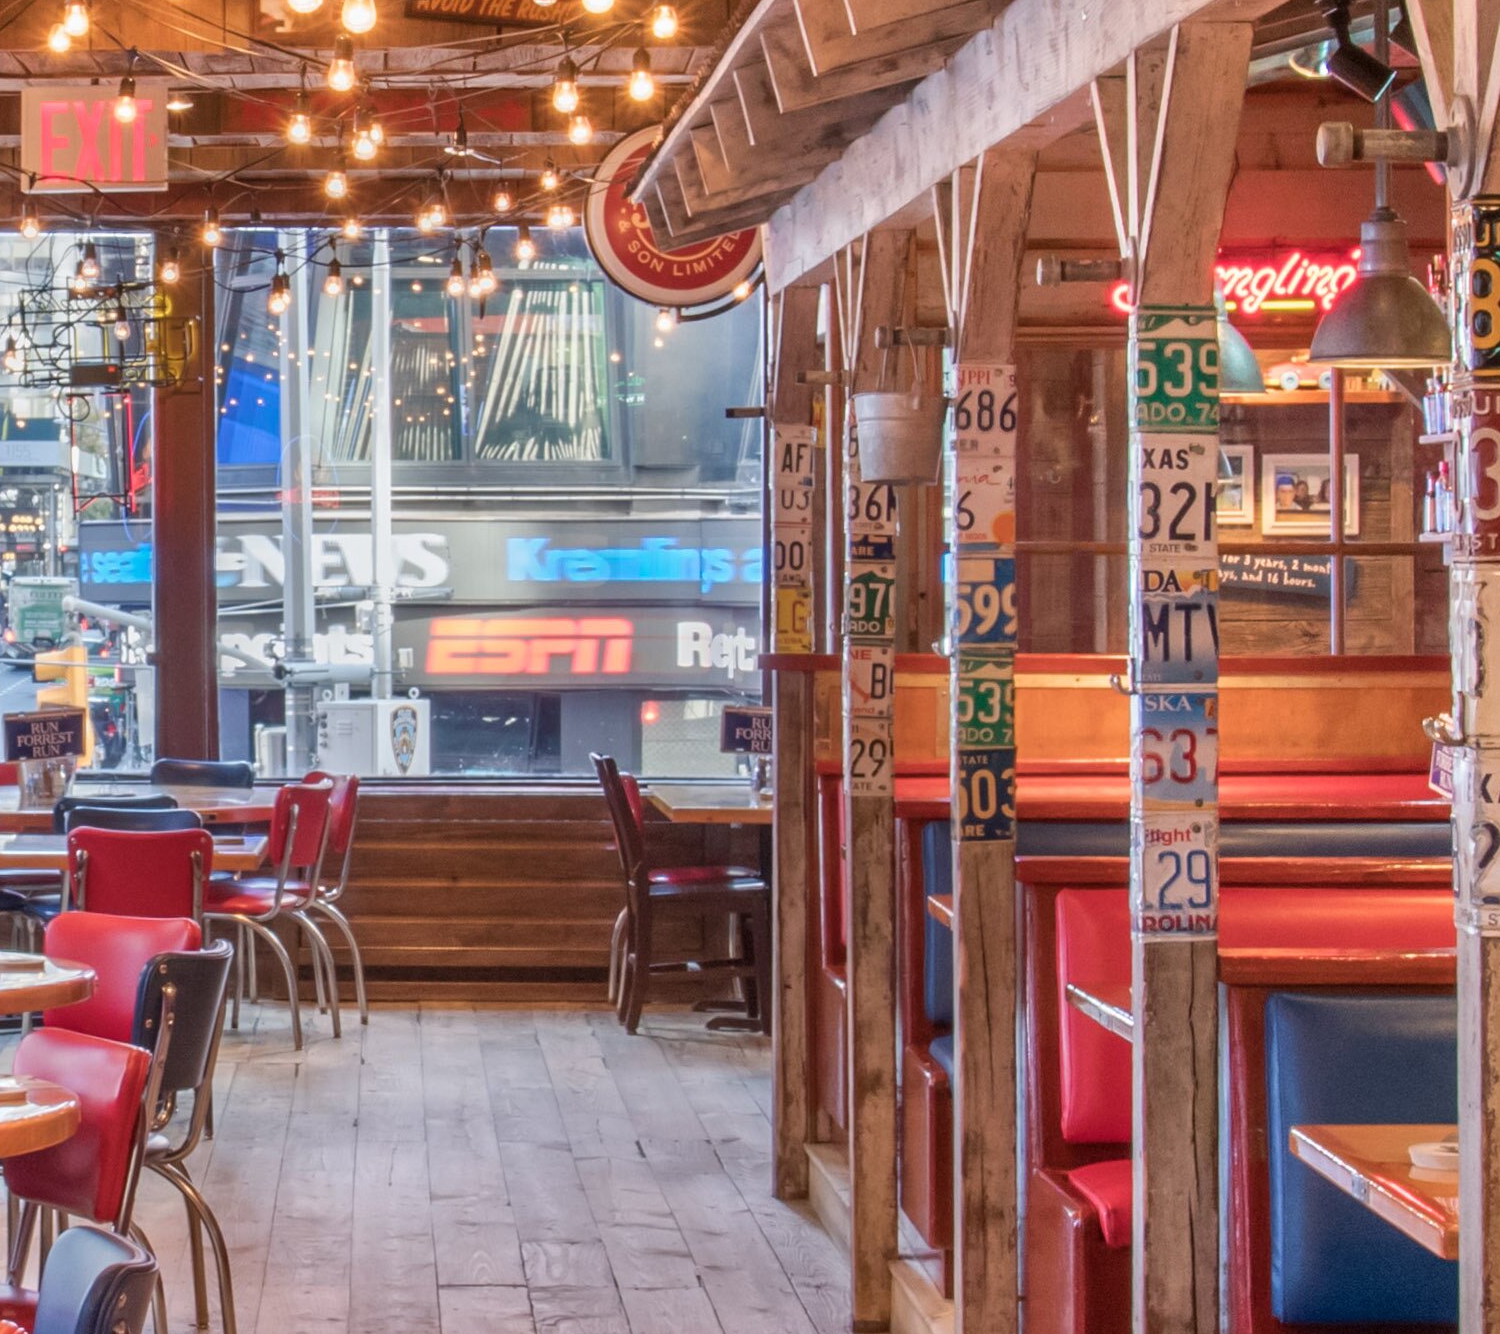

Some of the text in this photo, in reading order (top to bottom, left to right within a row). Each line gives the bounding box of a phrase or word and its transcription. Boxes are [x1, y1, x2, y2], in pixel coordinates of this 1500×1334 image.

[40, 99, 154, 183] EXIT
[628, 240, 664, 273] SON
[956, 390, 1017, 431] 686
[1244, 555, 1251, 566] 3
[1291, 559, 1299, 570] 2
[1267, 572, 1278, 584] 16
[425, 618, 634, 675] ESPN
[31, 721, 59, 734] RUN
[16, 731, 74, 748] FORREST
[33, 744, 60, 759] RUN
